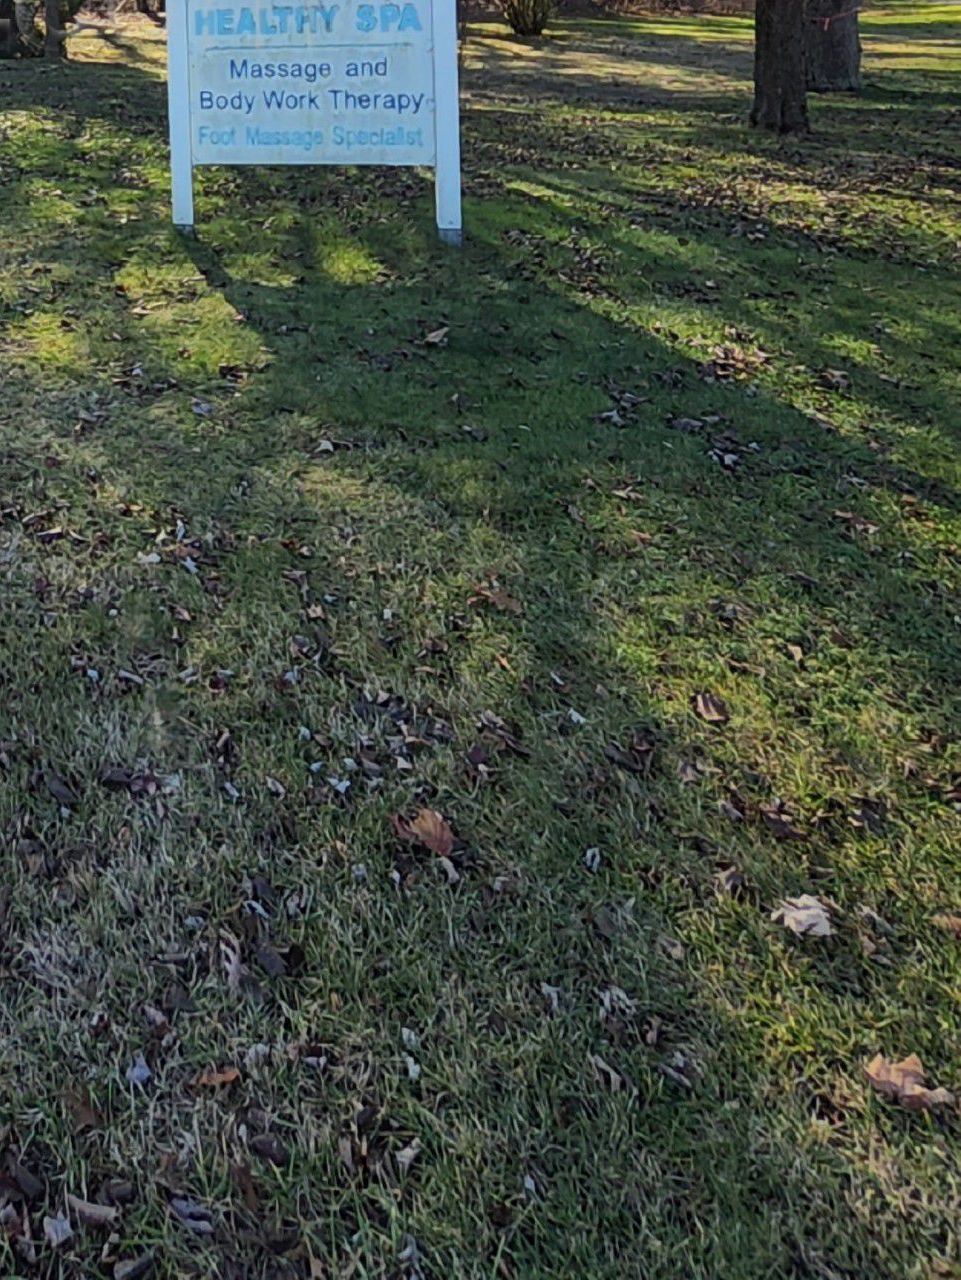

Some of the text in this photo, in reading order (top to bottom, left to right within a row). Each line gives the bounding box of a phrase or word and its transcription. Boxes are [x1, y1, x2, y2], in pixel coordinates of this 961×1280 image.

[195, 3, 423, 36] HEALTHY SPA
[230, 56, 388, 83] Massage and
[199, 88, 425, 115] Body Work Therapy
[198, 125, 424, 151] Foot Massage Specialist
